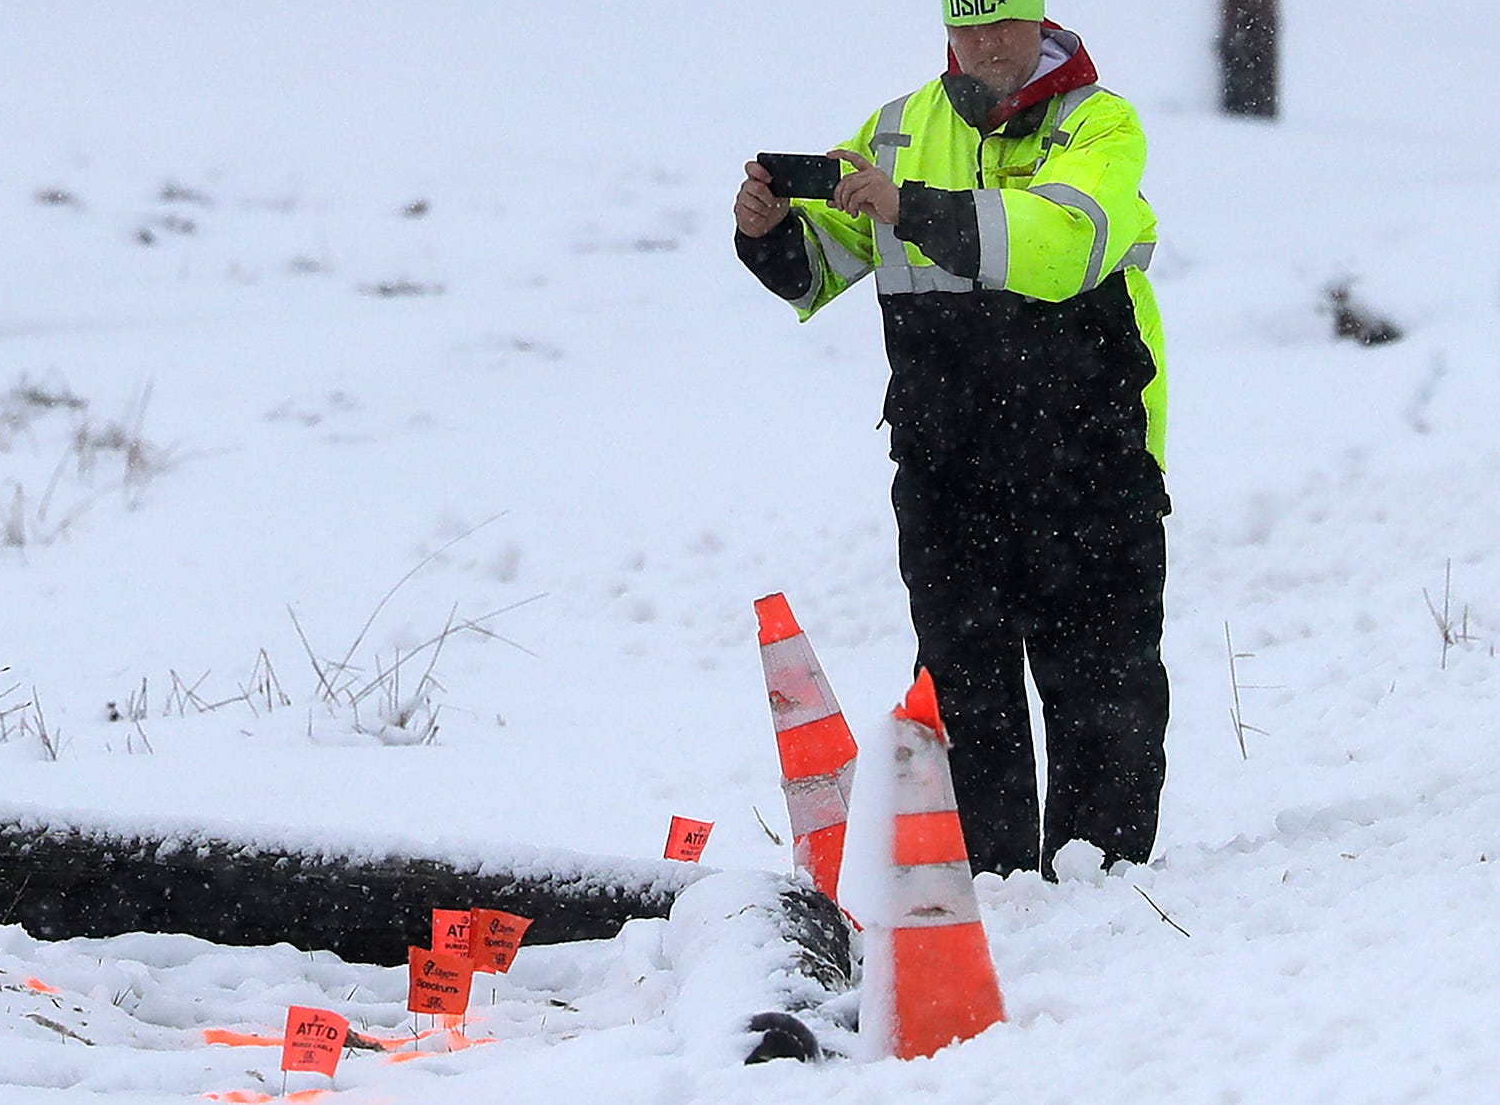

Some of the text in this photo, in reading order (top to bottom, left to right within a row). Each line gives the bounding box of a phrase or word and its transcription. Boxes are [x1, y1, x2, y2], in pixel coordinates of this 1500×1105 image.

[446, 923, 470, 938] AT
[415, 977, 456, 994] Spectrum
[296, 1022, 338, 1040] ATT/D
